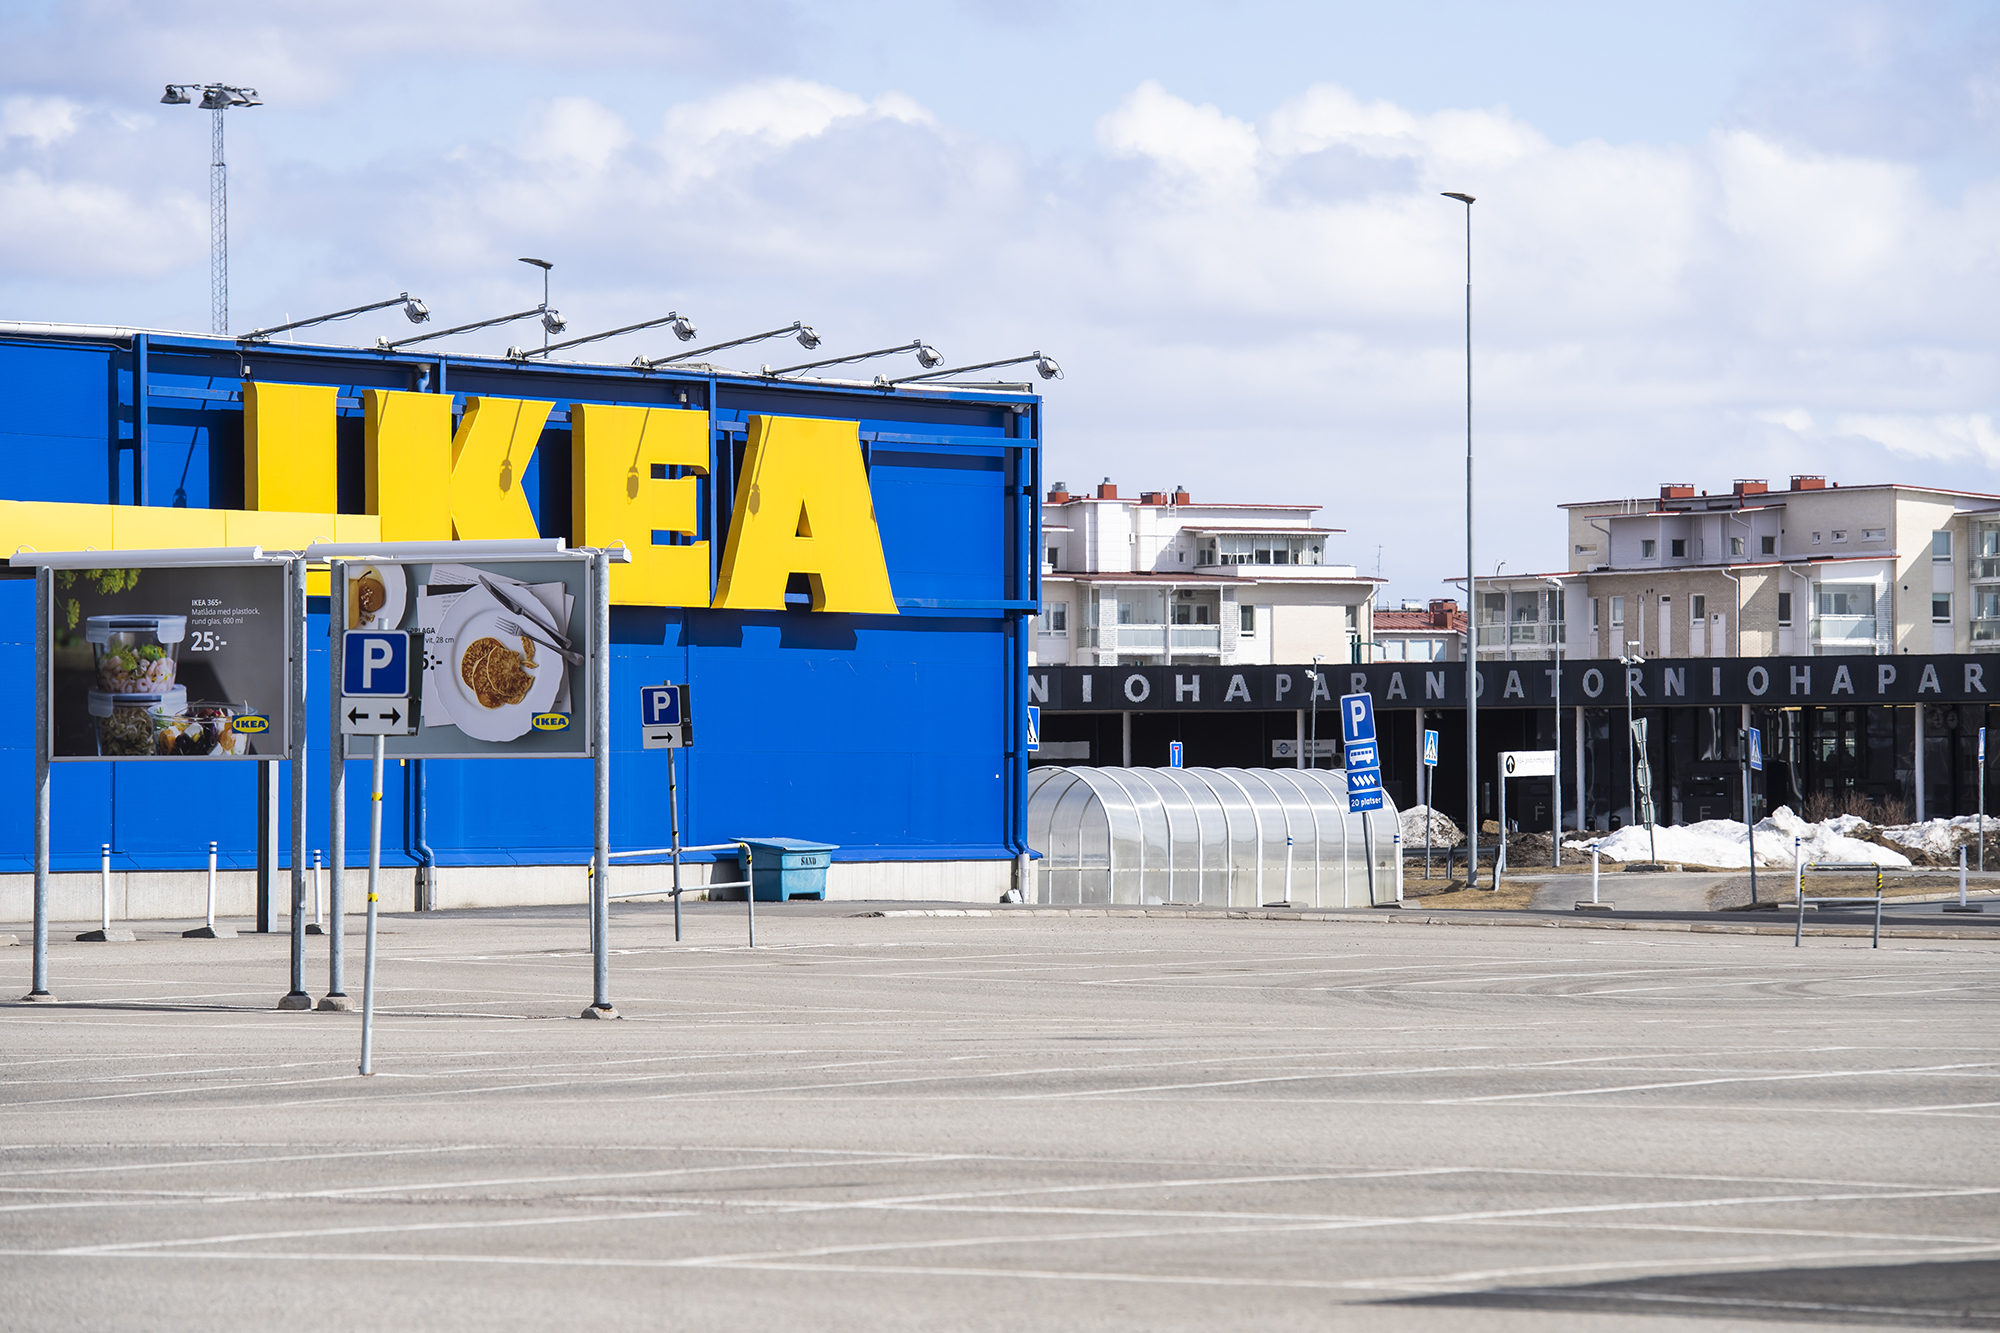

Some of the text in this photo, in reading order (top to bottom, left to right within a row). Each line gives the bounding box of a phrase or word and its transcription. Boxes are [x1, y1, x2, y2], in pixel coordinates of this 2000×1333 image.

[242, 380, 901, 614] IKEA
[191, 608, 216, 616] Matlåda
[231, 607, 260, 617] plastlock,
[191, 617, 207, 625] rund
[207, 617, 222, 627] glas,
[190, 631, 227, 651] 25:-
[435, 636, 444, 644] 28
[362, 638, 393, 689] P
[653, 691, 671, 721] P
[535, 717, 567, 726] IKEA
[1350, 699, 1367, 737] P
[235, 720, 267, 728] IKEA
[1350, 796, 1382, 808] 20 platser
[800, 856, 817, 866] SAND
